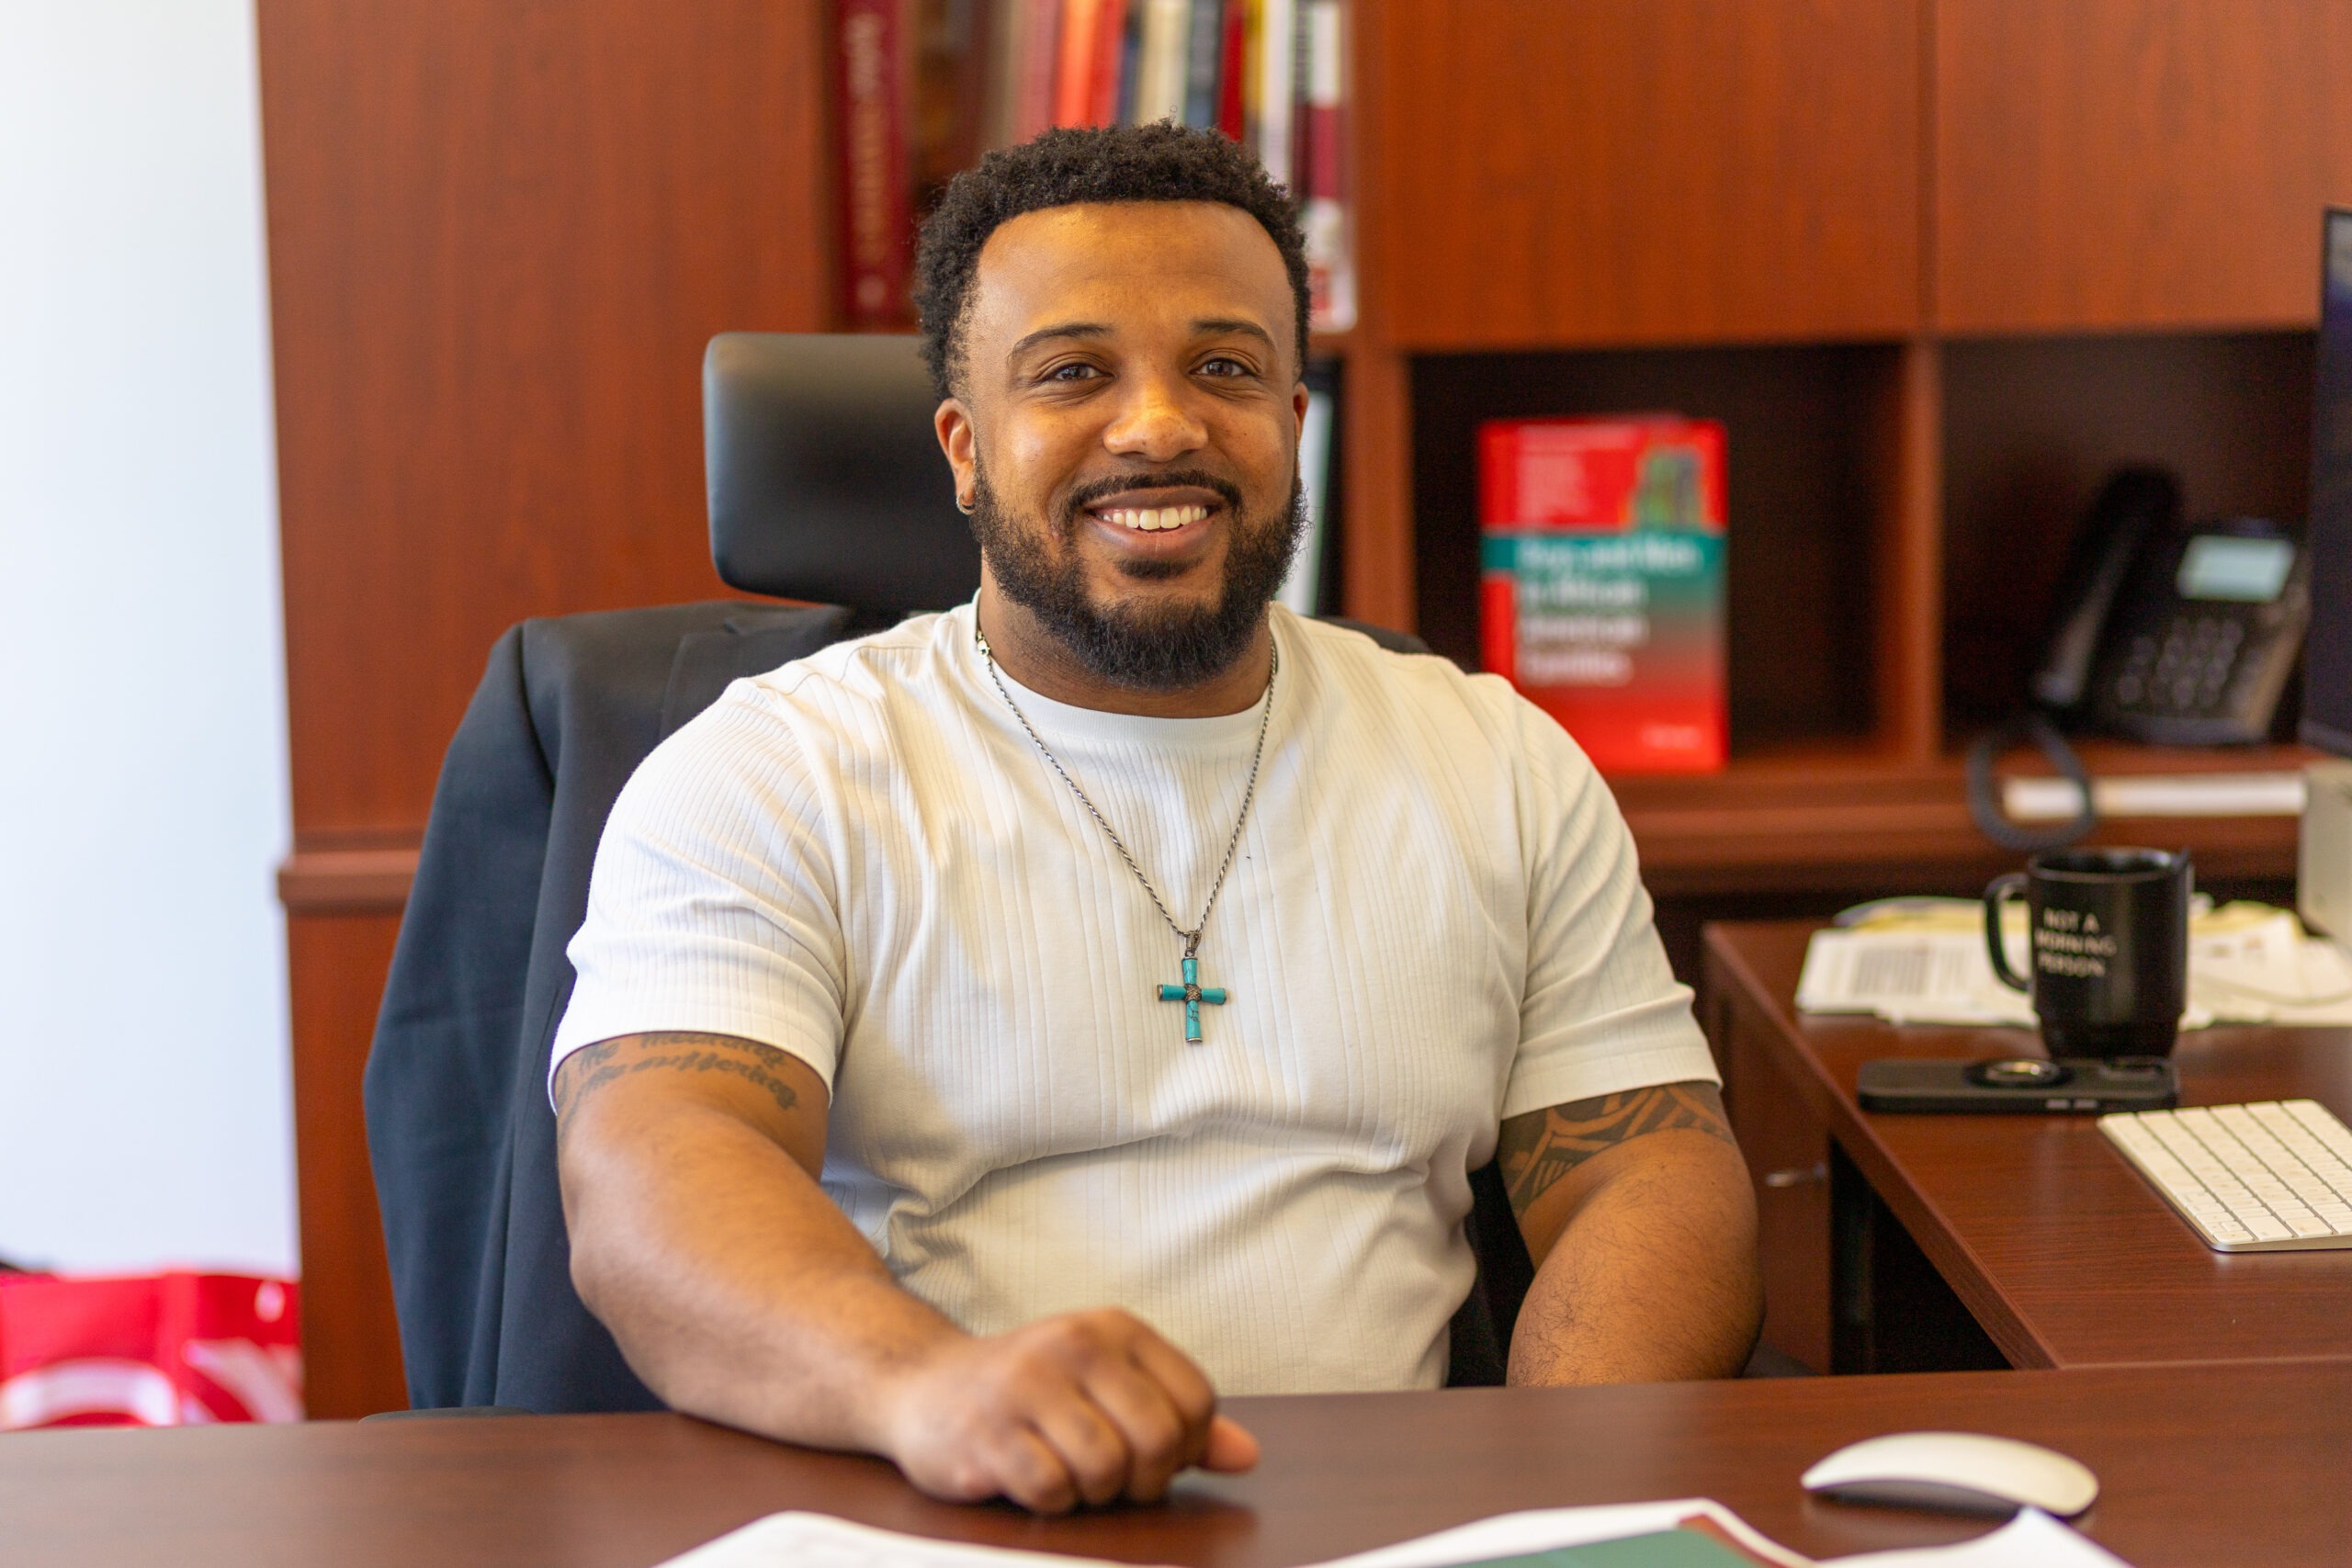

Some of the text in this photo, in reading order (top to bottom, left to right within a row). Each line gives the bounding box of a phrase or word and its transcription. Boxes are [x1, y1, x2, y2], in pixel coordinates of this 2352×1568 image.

[2044, 908, 2099, 934] NOT A
[2034, 927, 2117, 958] MORNING
[2038, 950, 2105, 978] PERSON
